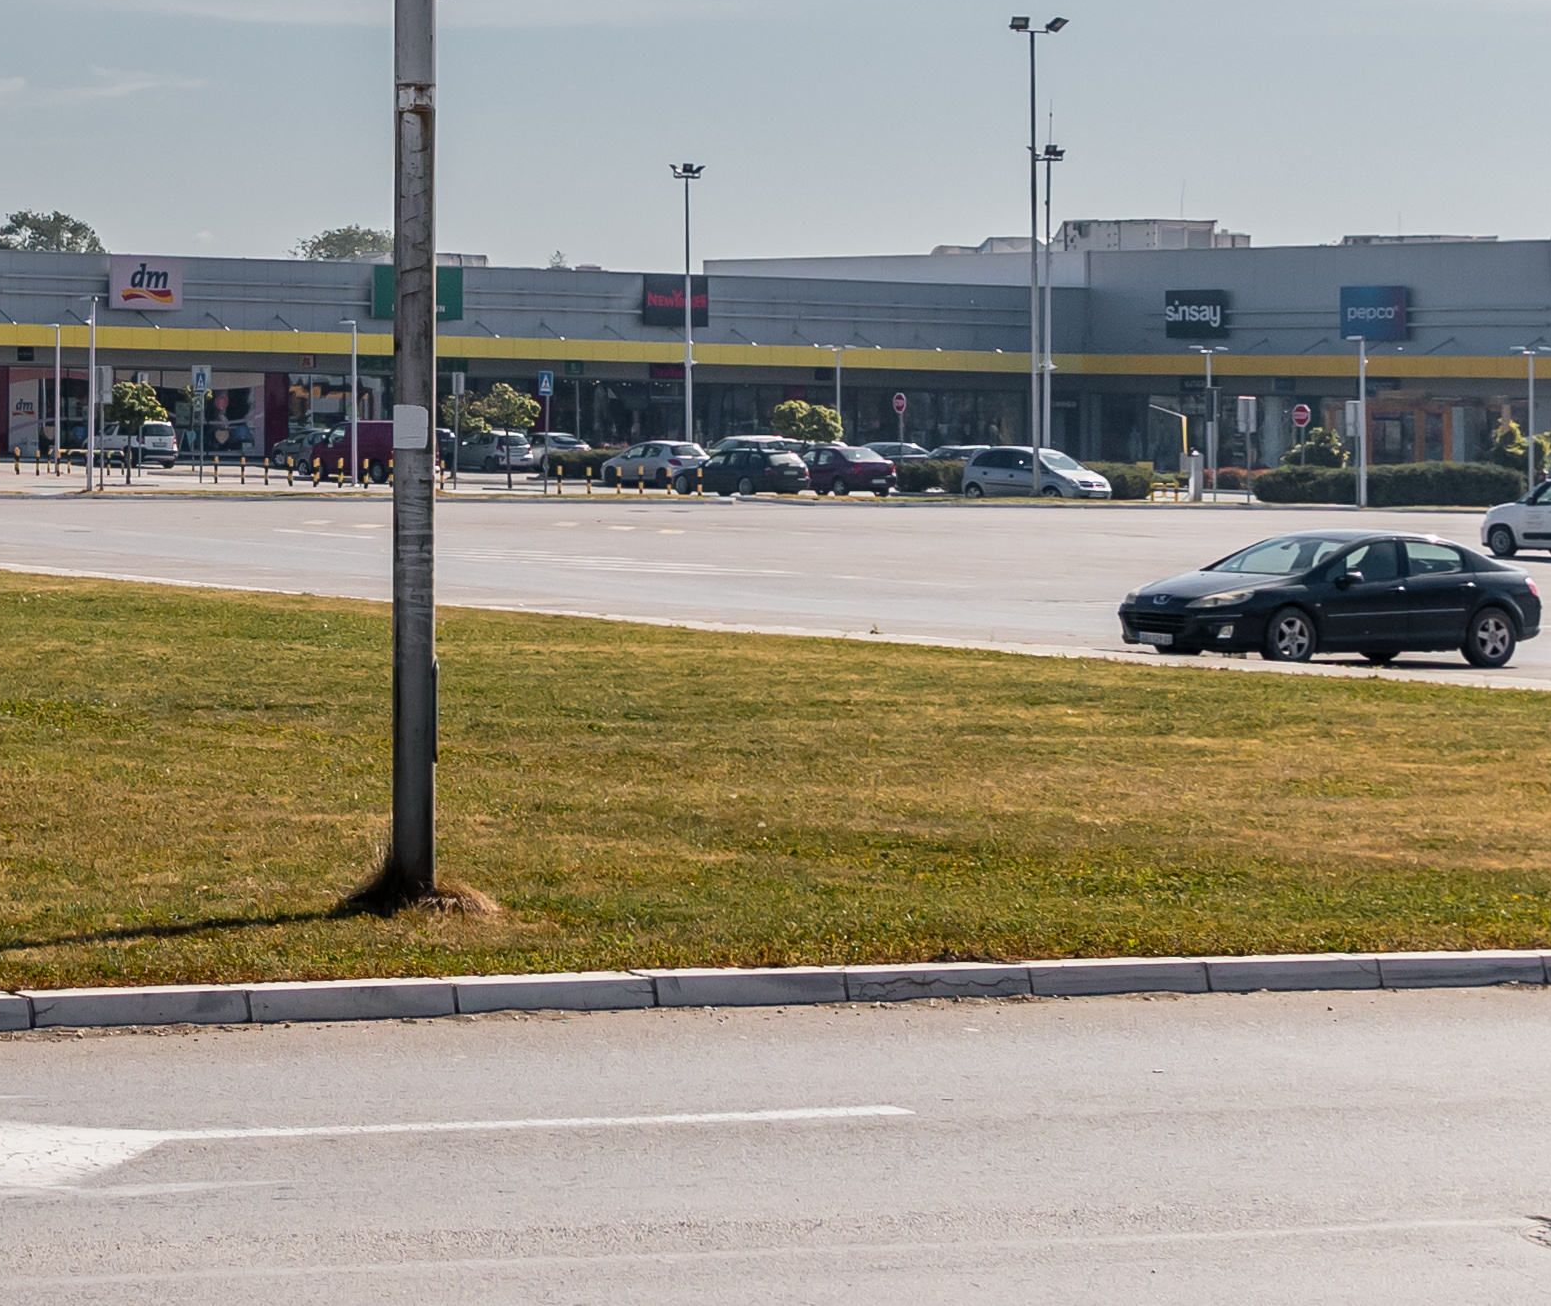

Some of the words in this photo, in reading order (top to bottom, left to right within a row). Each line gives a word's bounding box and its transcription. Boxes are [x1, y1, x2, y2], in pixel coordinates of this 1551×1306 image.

[129, 262, 169, 289] dm
[1164, 299, 1221, 328] sinsay
[1347, 306, 1395, 322] pepco
